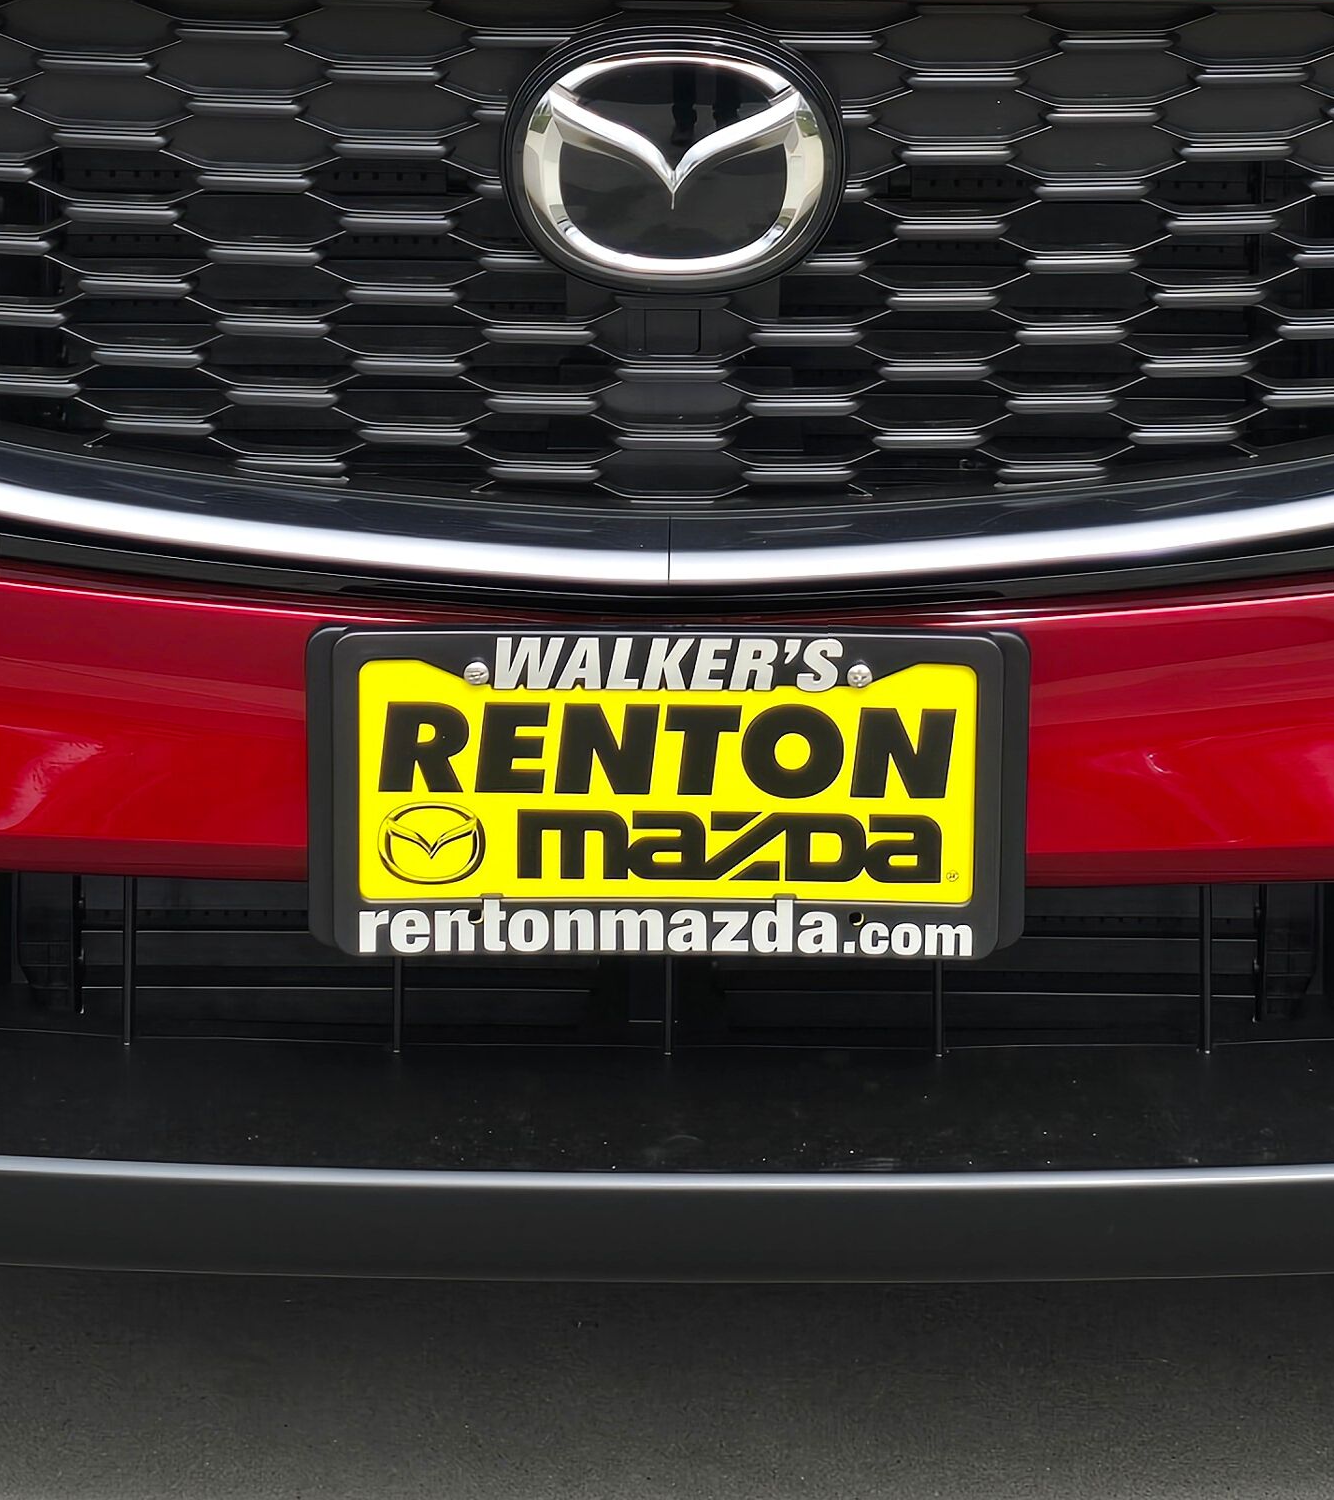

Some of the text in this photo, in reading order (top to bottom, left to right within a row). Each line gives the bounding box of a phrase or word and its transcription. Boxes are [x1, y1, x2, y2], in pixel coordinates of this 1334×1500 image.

[493, 637, 844, 693] WALKER'S
[378, 701, 957, 799] RENTON
[516, 808, 943, 884] mazda
[358, 899, 974, 958] rentonmazda.com
